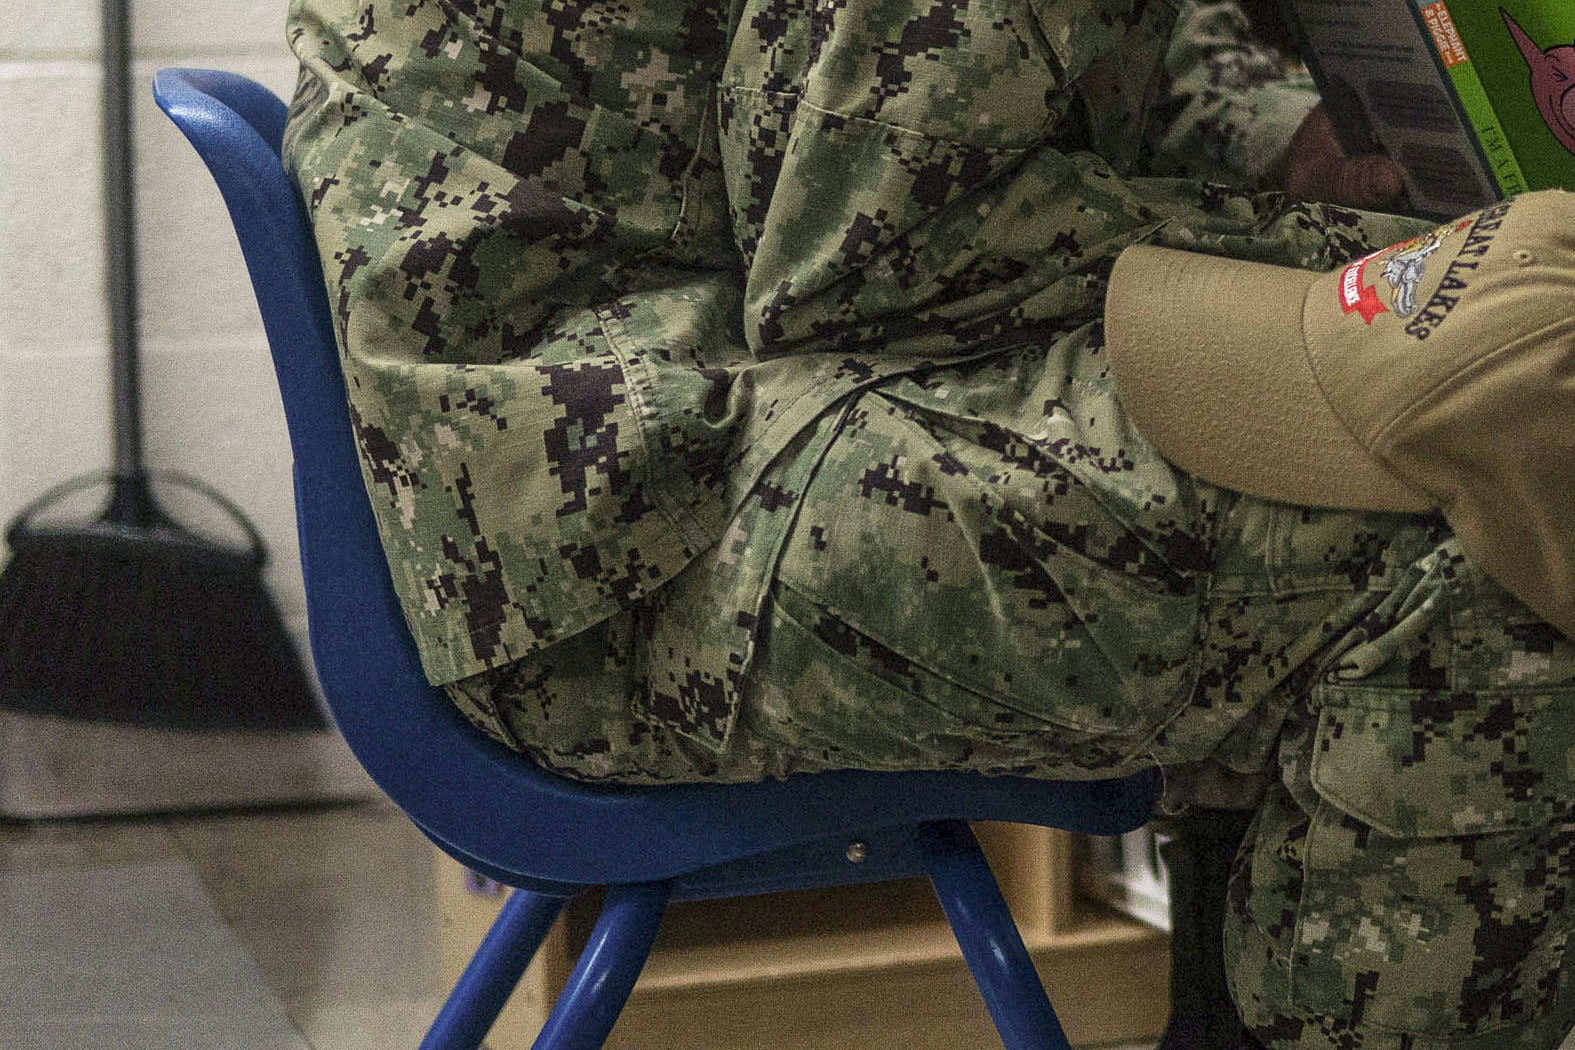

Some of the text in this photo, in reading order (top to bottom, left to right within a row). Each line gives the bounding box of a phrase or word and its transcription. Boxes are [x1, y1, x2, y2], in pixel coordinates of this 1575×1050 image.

[1437, 10, 1468, 62] ELEPHANT
[1457, 200, 1514, 257] REAT
[1404, 260, 1479, 340] LAKES
